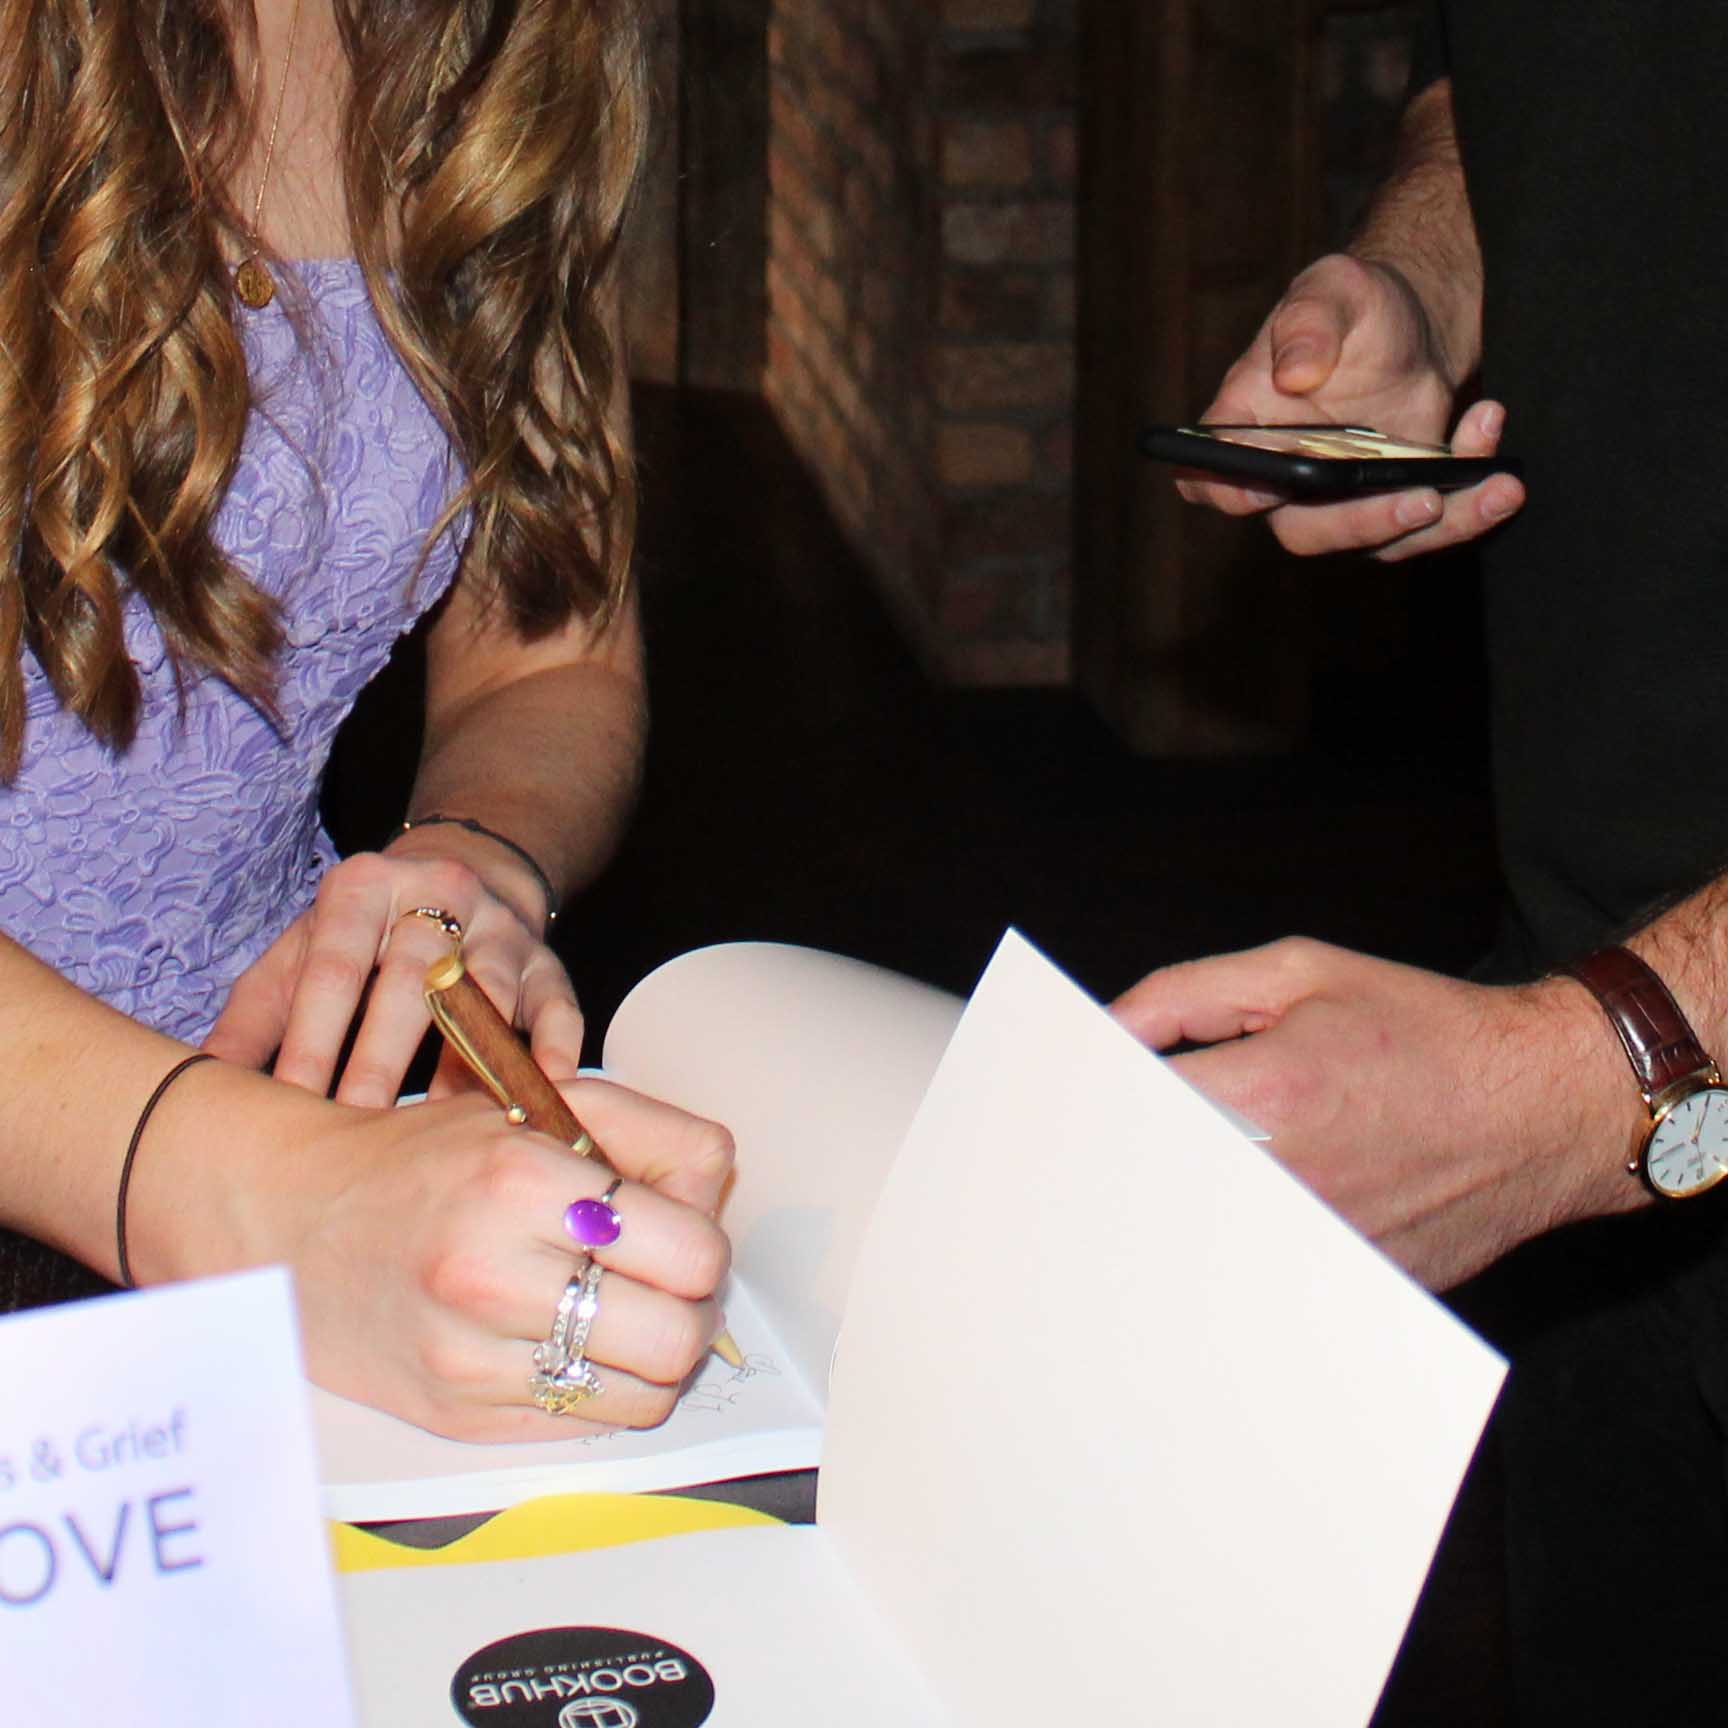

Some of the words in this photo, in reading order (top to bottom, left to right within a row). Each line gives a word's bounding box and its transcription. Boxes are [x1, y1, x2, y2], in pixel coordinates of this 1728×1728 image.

[27, 1435, 64, 1483] &
[75, 1409, 190, 1474] Grief
[470, 1667, 536, 1683] GROUP
[543, 1650, 666, 1674] PUBLISHING
[468, 1658, 688, 1707] BOOKHUB
